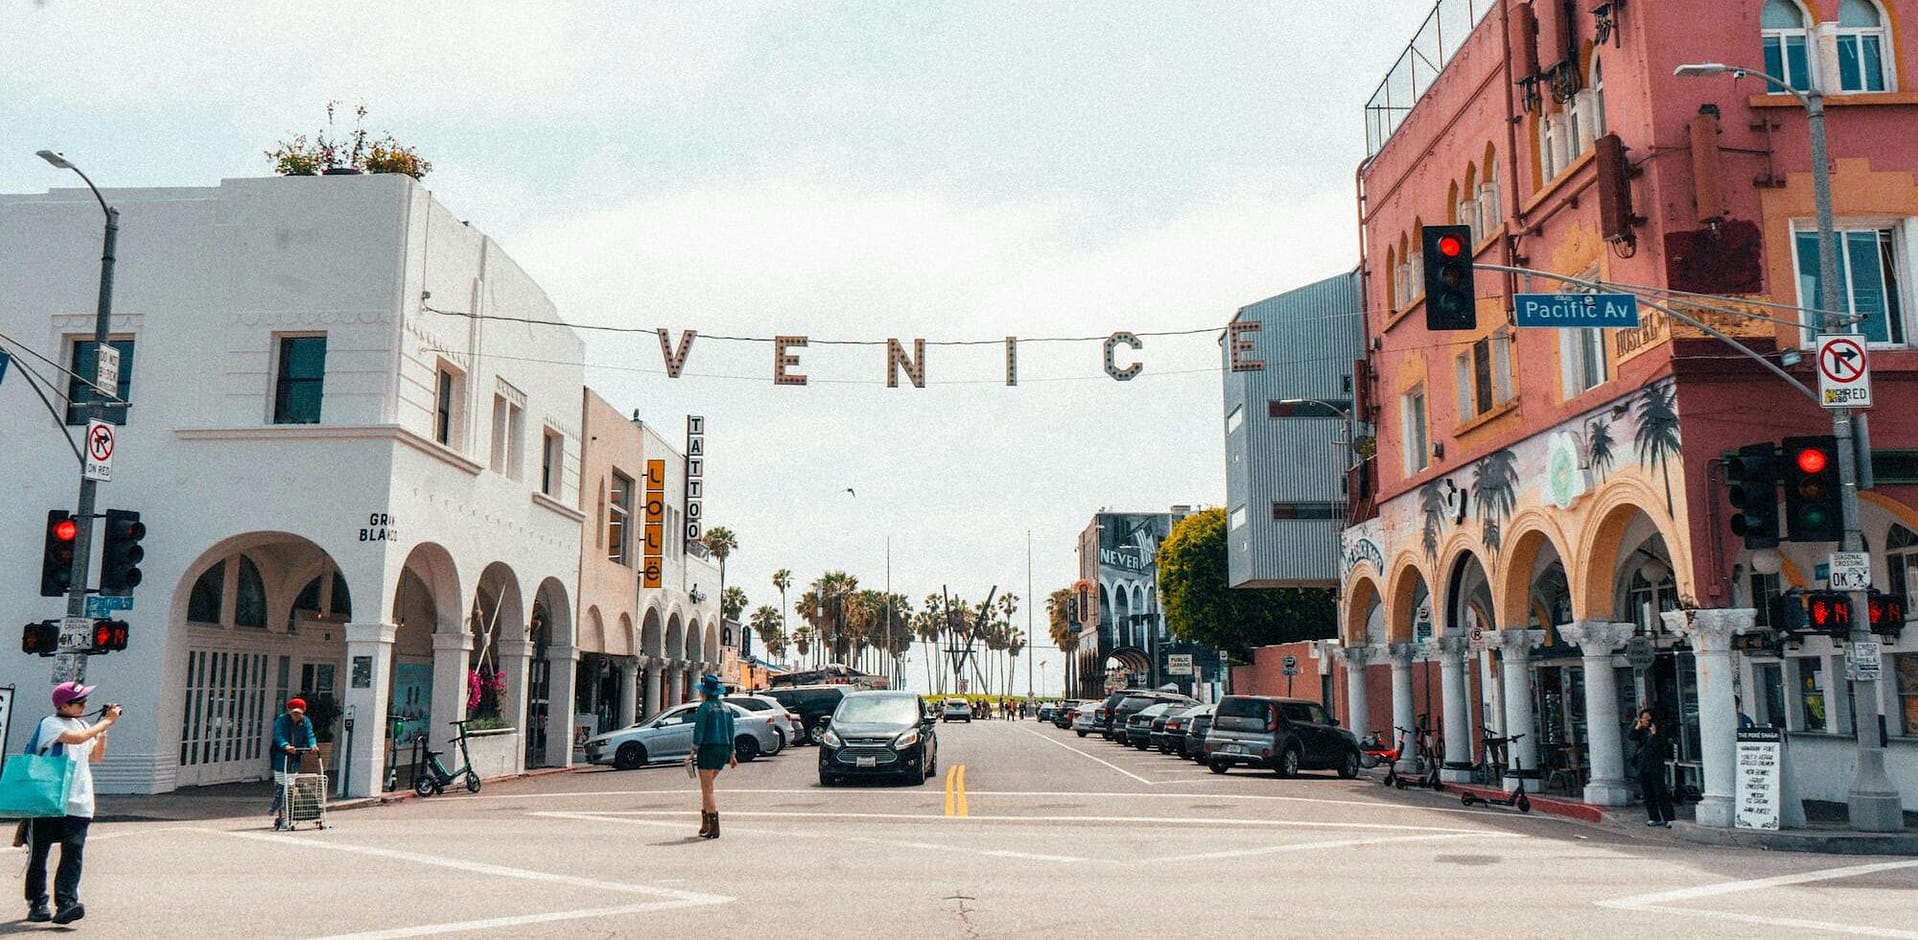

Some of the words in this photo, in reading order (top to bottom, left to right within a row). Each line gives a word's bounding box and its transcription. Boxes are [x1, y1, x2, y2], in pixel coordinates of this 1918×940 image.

[1525, 301, 1597, 318] Pacific
[1604, 301, 1628, 318] Av
[656, 320, 1264, 388] VENICE
[1846, 388, 1867, 400] RED
[87, 463, 97, 473] ON
[98, 465, 111, 477] RED
[688, 418, 701, 538] TATTOO
[1100, 548, 1139, 569] NEVER
[1832, 572, 1848, 586] OK
